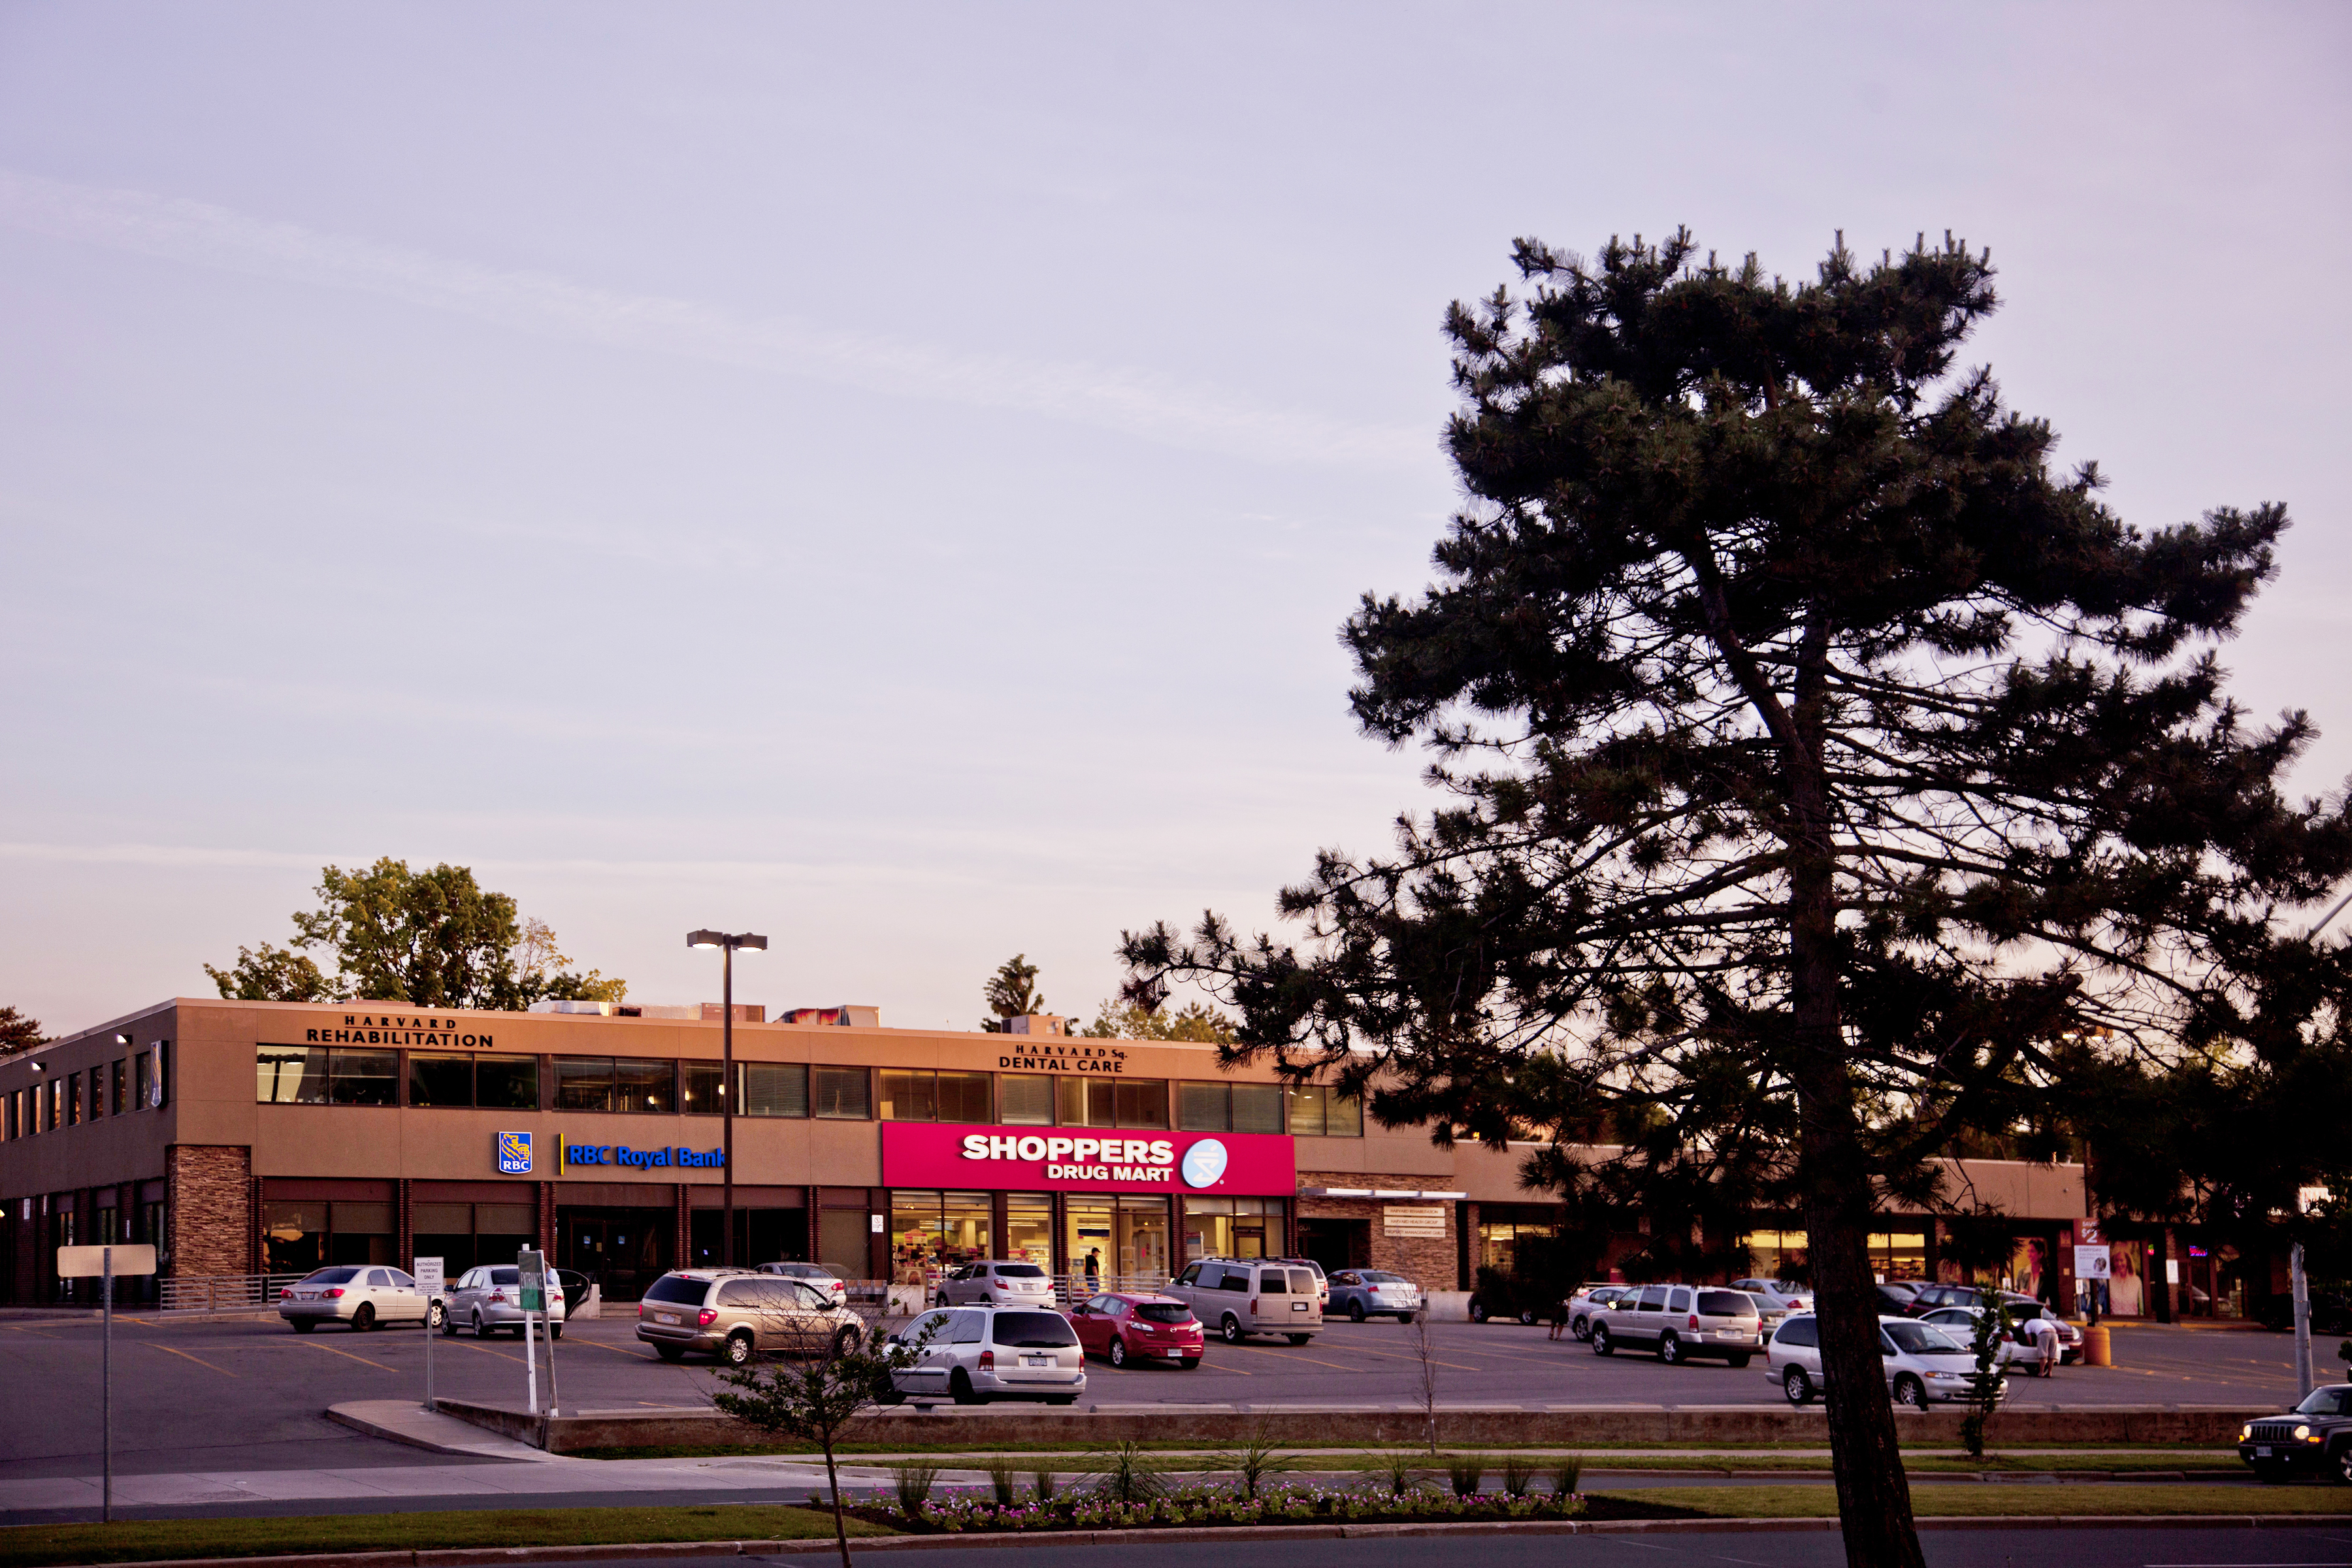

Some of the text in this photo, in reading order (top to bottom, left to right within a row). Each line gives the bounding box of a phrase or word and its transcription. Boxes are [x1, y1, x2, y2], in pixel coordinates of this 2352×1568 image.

[345, 1016, 456, 1028] HARVARD
[307, 1029, 493, 1047] REHABILITATION
[1016, 1045, 1128, 1060] HARVARD Sq.
[1000, 1056, 1122, 1072] DENTAL CARE
[570, 1145, 612, 1165] RBC
[617, 1146, 674, 1170] Royal
[963, 1134, 1175, 1165] SHOPPERS
[502, 1160, 529, 1171] RBC
[1048, 1164, 1173, 1182] DRUG MART
